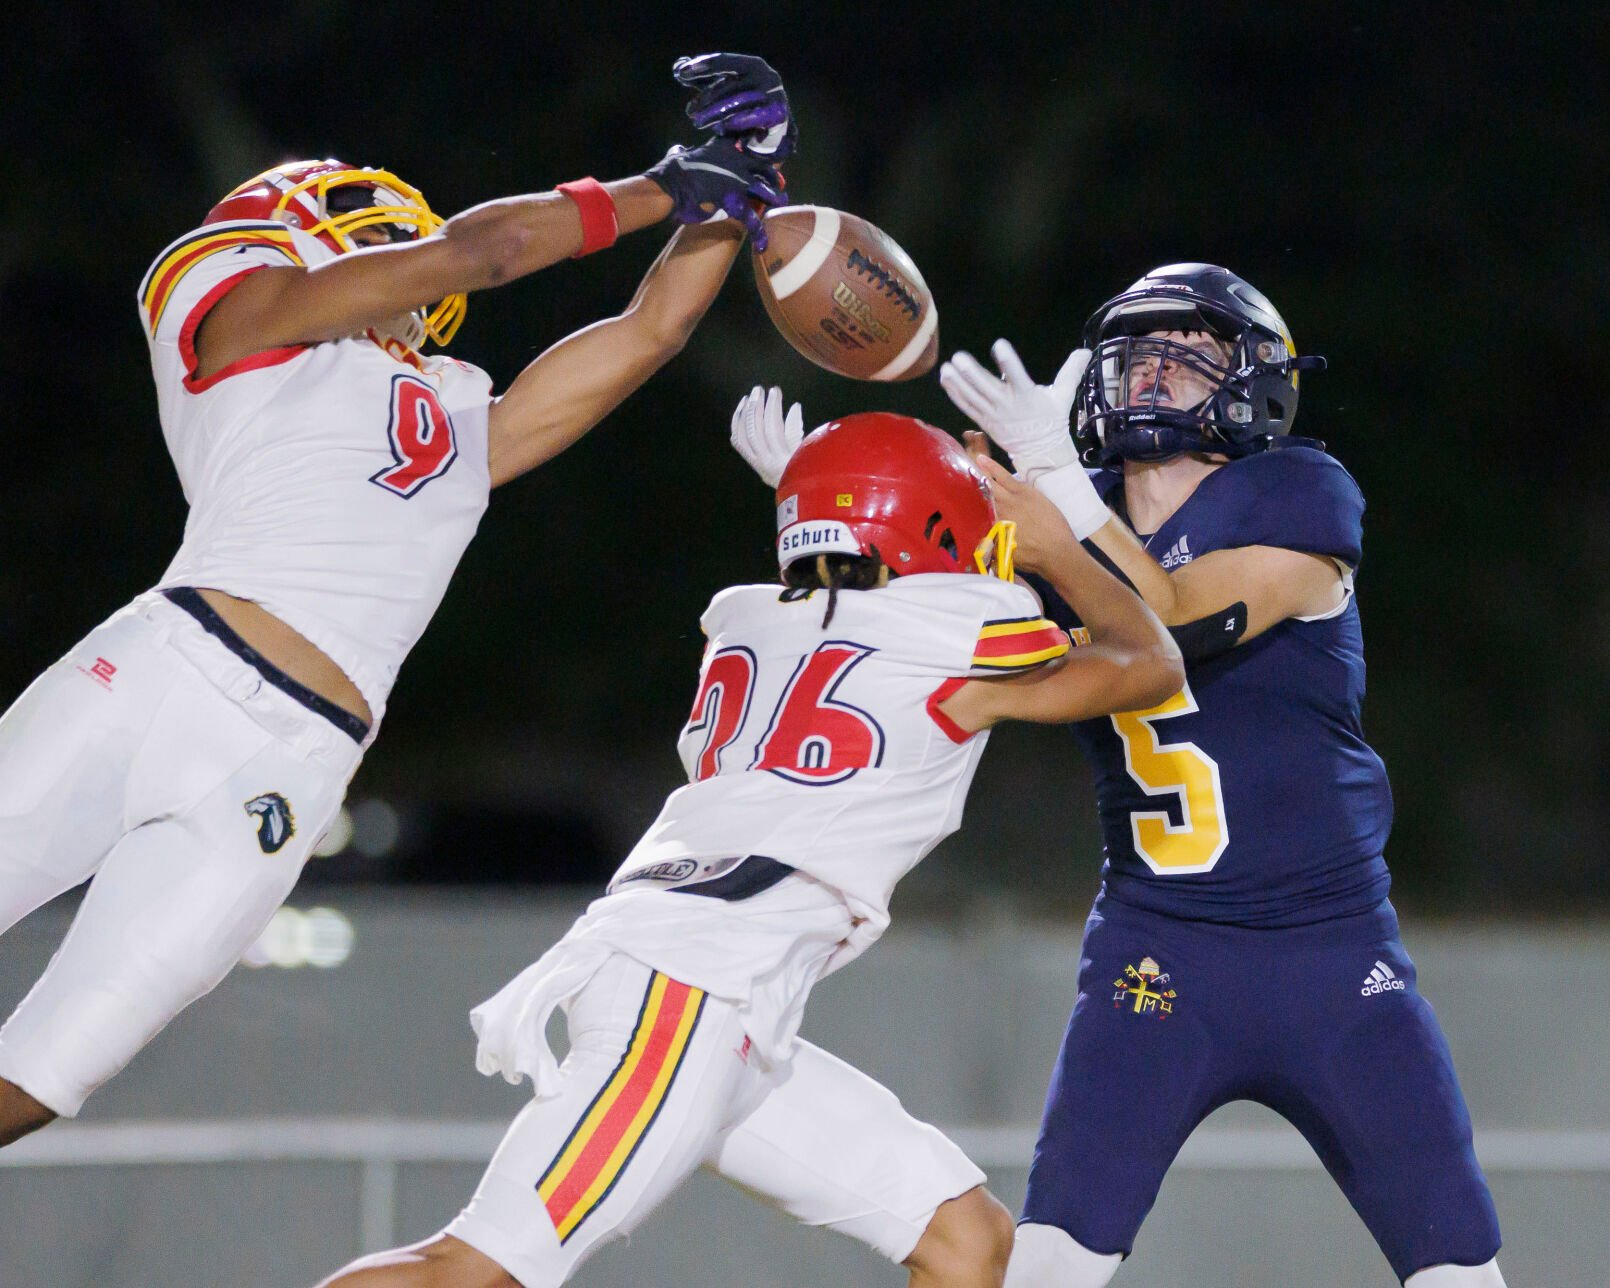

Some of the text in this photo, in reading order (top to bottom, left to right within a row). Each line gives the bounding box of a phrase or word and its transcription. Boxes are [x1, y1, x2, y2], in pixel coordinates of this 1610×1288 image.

[368, 373, 459, 501] 9
[1110, 679, 1230, 876] 5
[1143, 997, 1156, 1012] M
[1361, 979, 1405, 997] adidas
